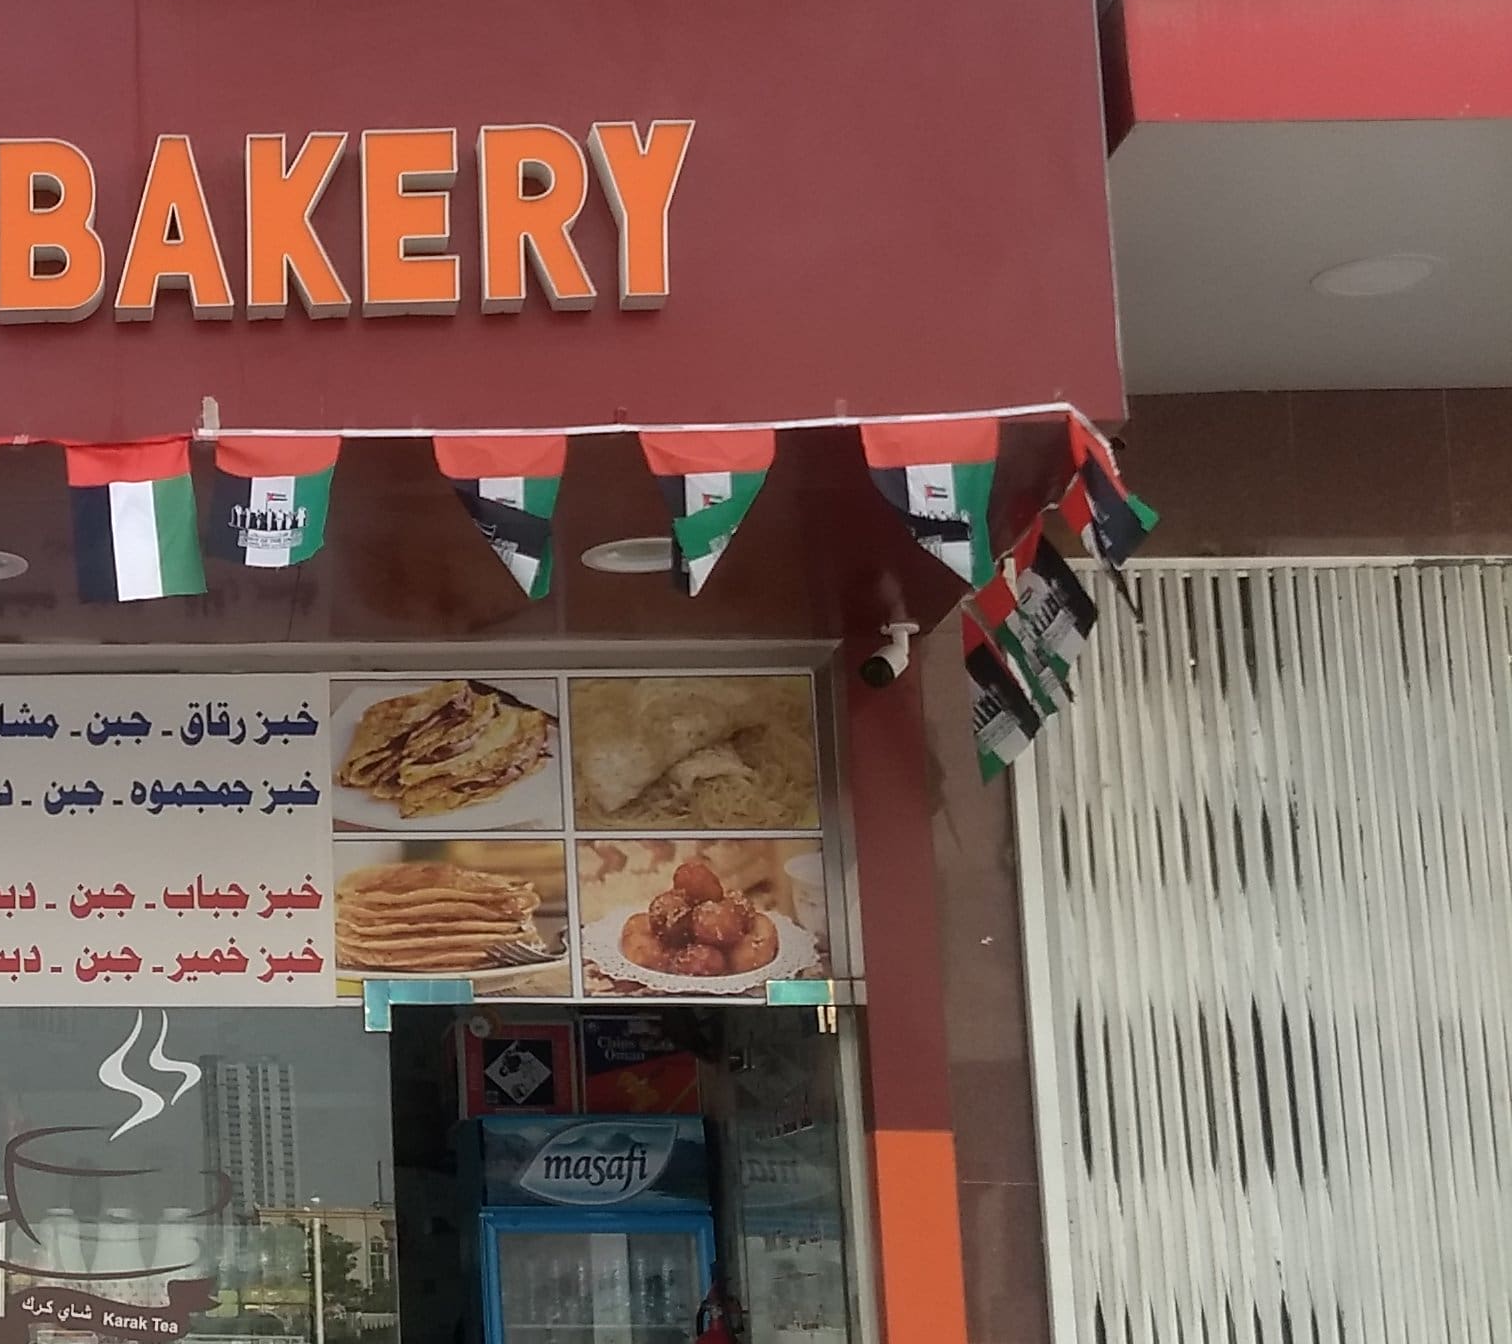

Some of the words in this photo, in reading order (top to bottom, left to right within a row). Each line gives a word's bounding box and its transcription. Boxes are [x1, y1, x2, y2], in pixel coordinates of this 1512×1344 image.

[87, 710, 152, 746] جبن
[180, 701, 246, 745] رقاق
[253, 701, 319, 745] خبز
[44, 779, 104, 816] جبن
[130, 779, 253, 815] جمجموه
[259, 770, 320, 815] خبز
[69, 883, 135, 919] جبن
[163, 873, 249, 919] جباب
[256, 874, 323, 919] خبز
[75, 946, 142, 983] جبن
[167, 937, 249, 983] خمير
[256, 937, 324, 983] خبز
[543, 1143, 648, 1191] masafi
[21, 1296, 54, 1315] كرك
[57, 1303, 92, 1322] شاي
[103, 1312, 148, 1331] Karak
[152, 1317, 178, 1334] Tea
